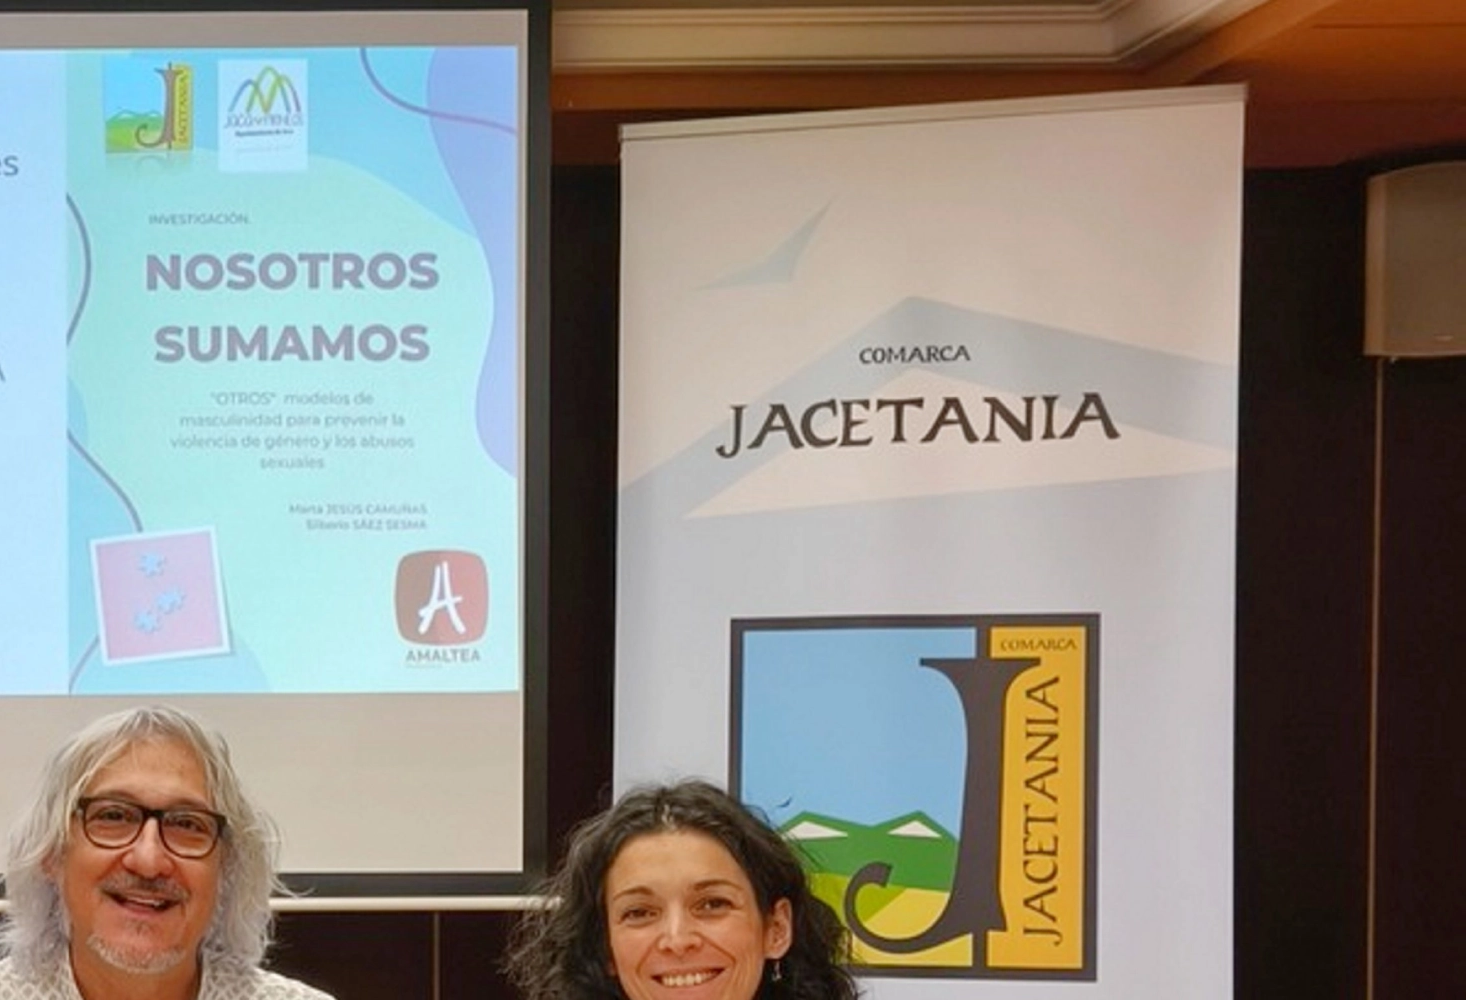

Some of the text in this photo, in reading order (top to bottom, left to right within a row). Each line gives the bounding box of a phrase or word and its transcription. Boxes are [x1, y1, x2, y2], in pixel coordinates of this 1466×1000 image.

[146, 252, 439, 291] NOSOTROS
[154, 324, 430, 363] SUMAMOS
[859, 345, 970, 364] COMARCA
[284, 391, 350, 406] modelos
[353, 391, 374, 405] de
[179, 413, 405, 428] masculinidad para prevenir la
[716, 392, 1120, 458] JACETANIA
[170, 434, 238, 449] violencia
[241, 435, 260, 448] de
[323, 437, 332, 450] y
[335, 434, 357, 448] los
[360, 434, 414, 449] abusos
[260, 455, 325, 469] sexuales
[1000, 638, 1077, 651] COMARCA
[405, 649, 481, 663] AMALTEA
[1020, 673, 1062, 946] JACETANIA
